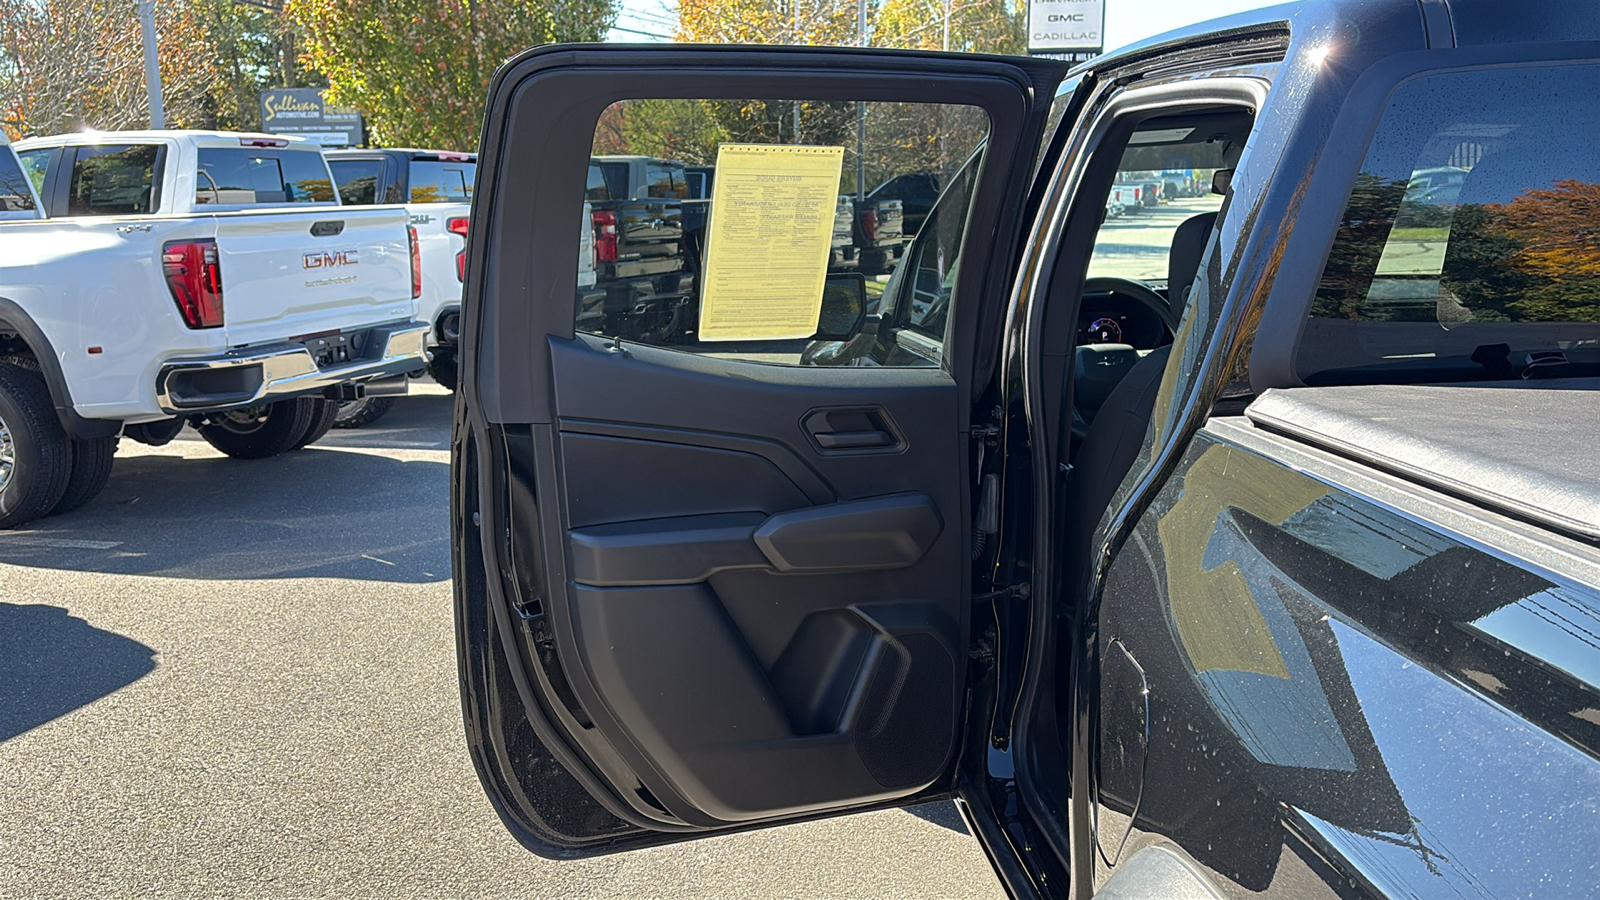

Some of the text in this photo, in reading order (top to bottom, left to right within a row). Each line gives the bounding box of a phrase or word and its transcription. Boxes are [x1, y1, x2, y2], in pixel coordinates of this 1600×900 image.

[1048, 14, 1084, 22] GMC
[1033, 32, 1097, 40] CADILLAC
[264, 95, 319, 121] Sullivan
[276, 111, 320, 119] AUTOMOTIVE.COM
[303, 249, 359, 269] GMC
